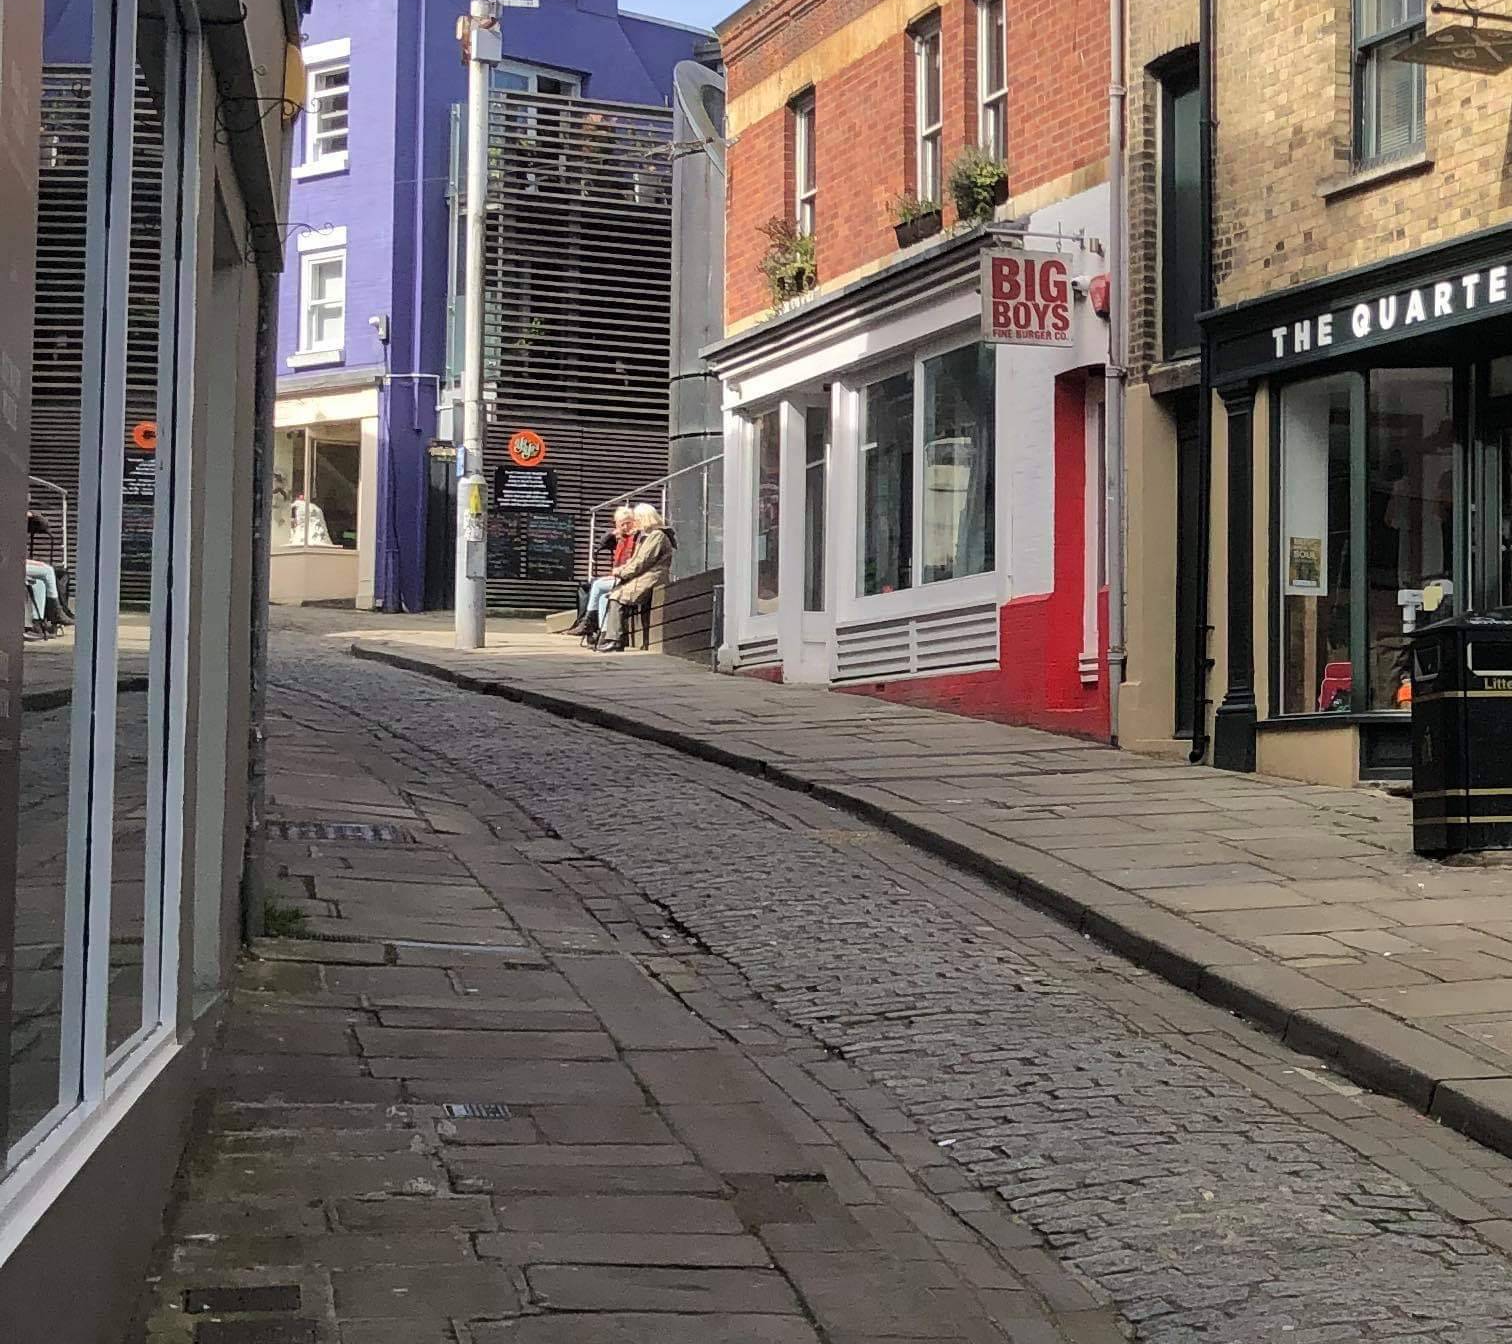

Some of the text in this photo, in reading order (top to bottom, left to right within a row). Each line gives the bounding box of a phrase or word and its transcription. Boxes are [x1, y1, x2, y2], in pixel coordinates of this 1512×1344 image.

[991, 257, 1068, 304] BIG
[992, 301, 1070, 331] BOYS
[993, 329, 1012, 338] FINE
[1016, 329, 1052, 340] BURGER
[1271, 312, 1334, 358] THE
